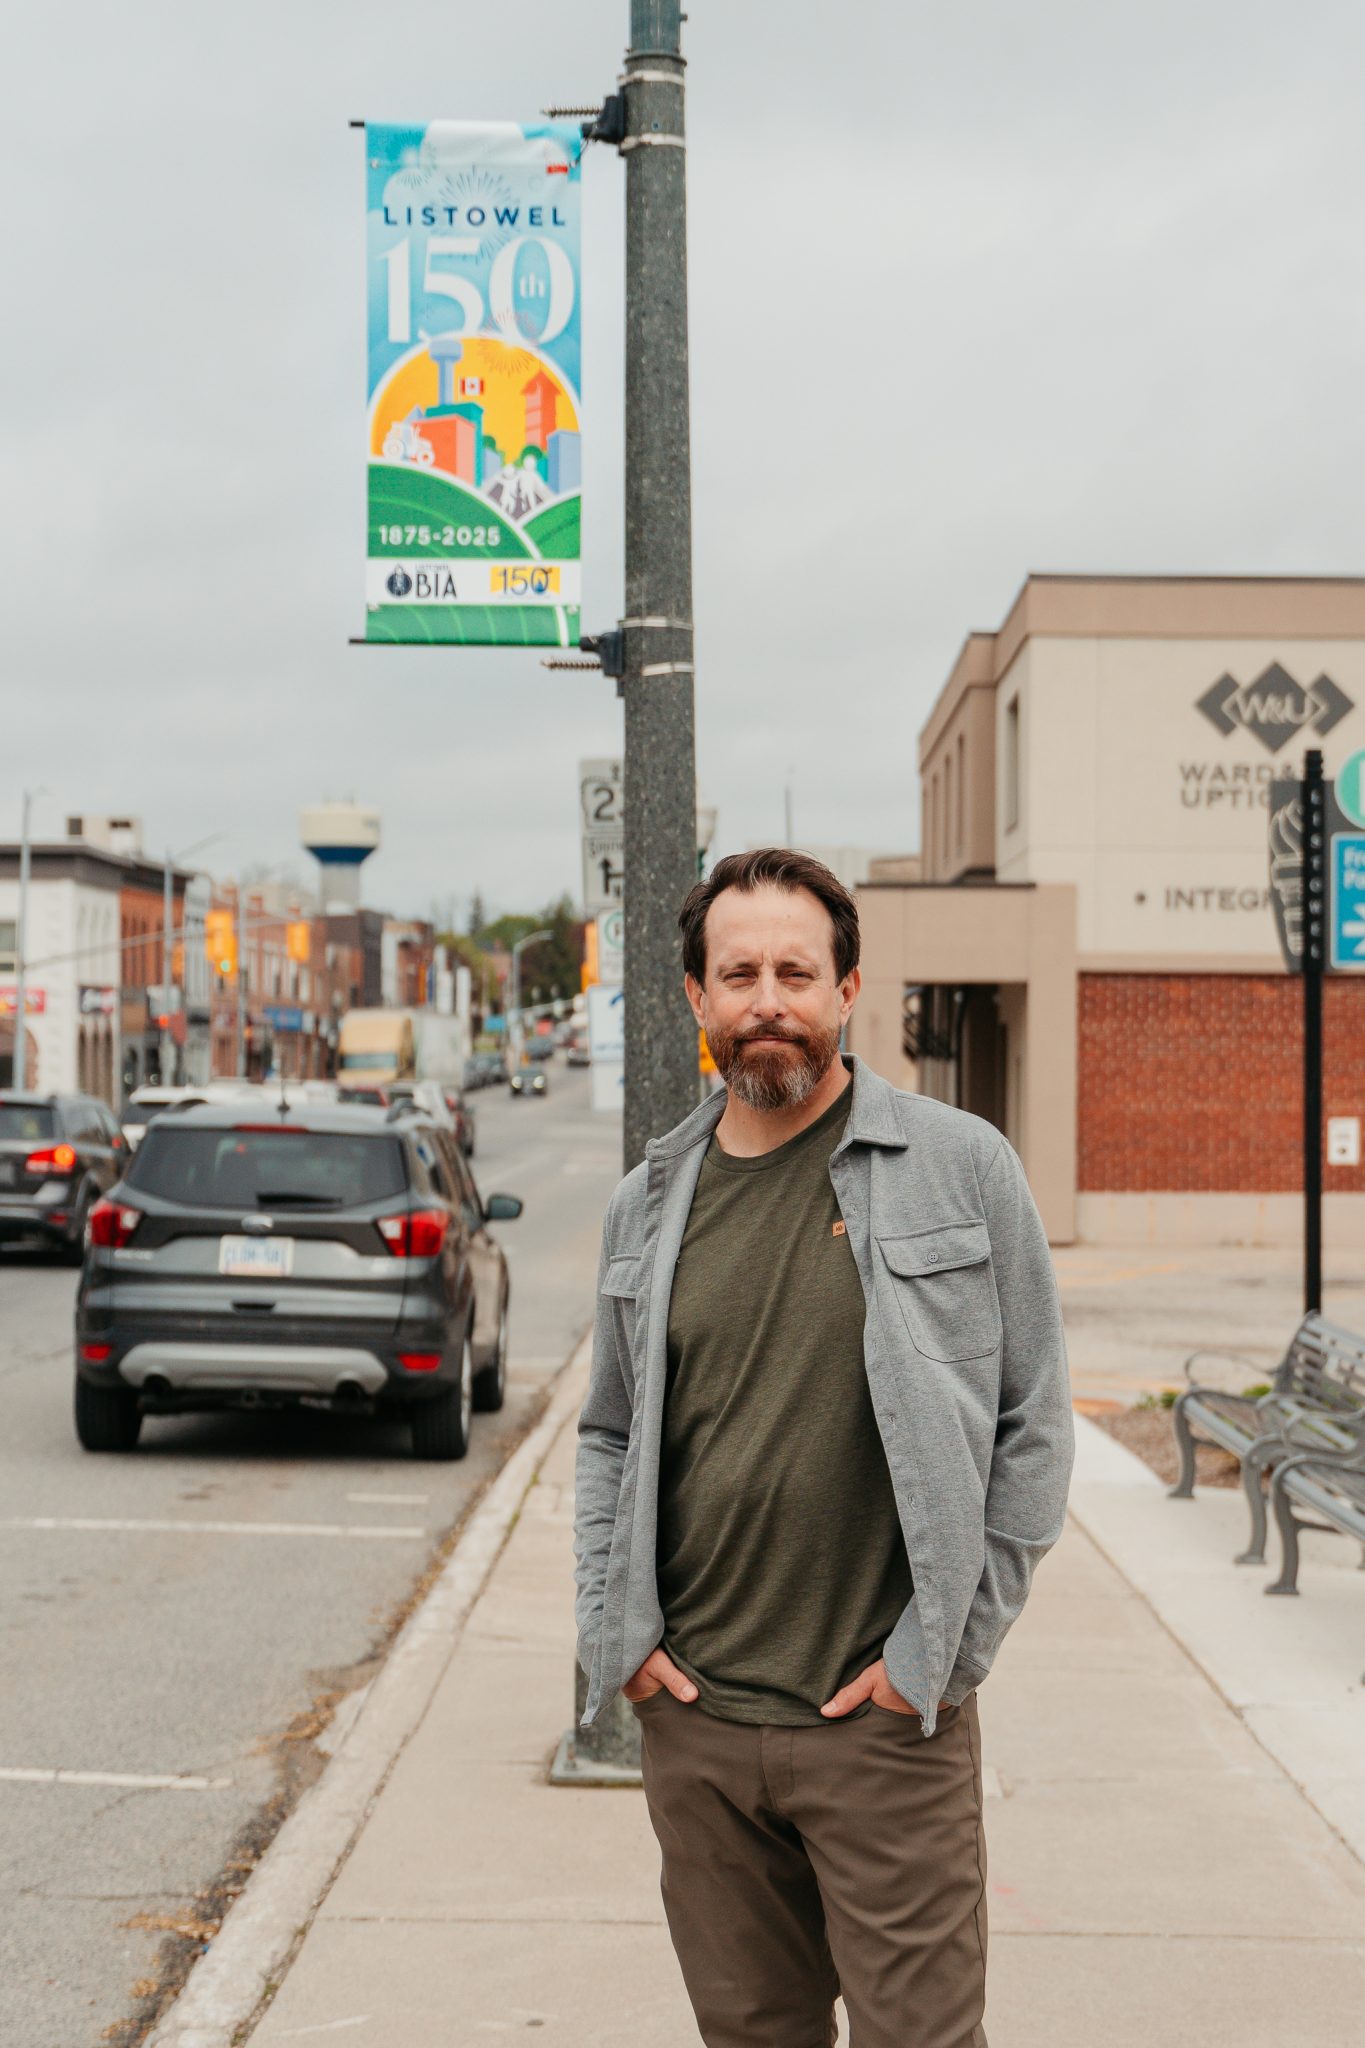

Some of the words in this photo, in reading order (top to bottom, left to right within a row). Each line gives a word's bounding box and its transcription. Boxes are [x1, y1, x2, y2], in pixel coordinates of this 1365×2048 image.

[384, 206, 566, 226] LISTOWEL
[375, 236, 575, 344] 150
[379, 525, 501, 546] 1875-2025
[416, 573, 457, 598] BIA
